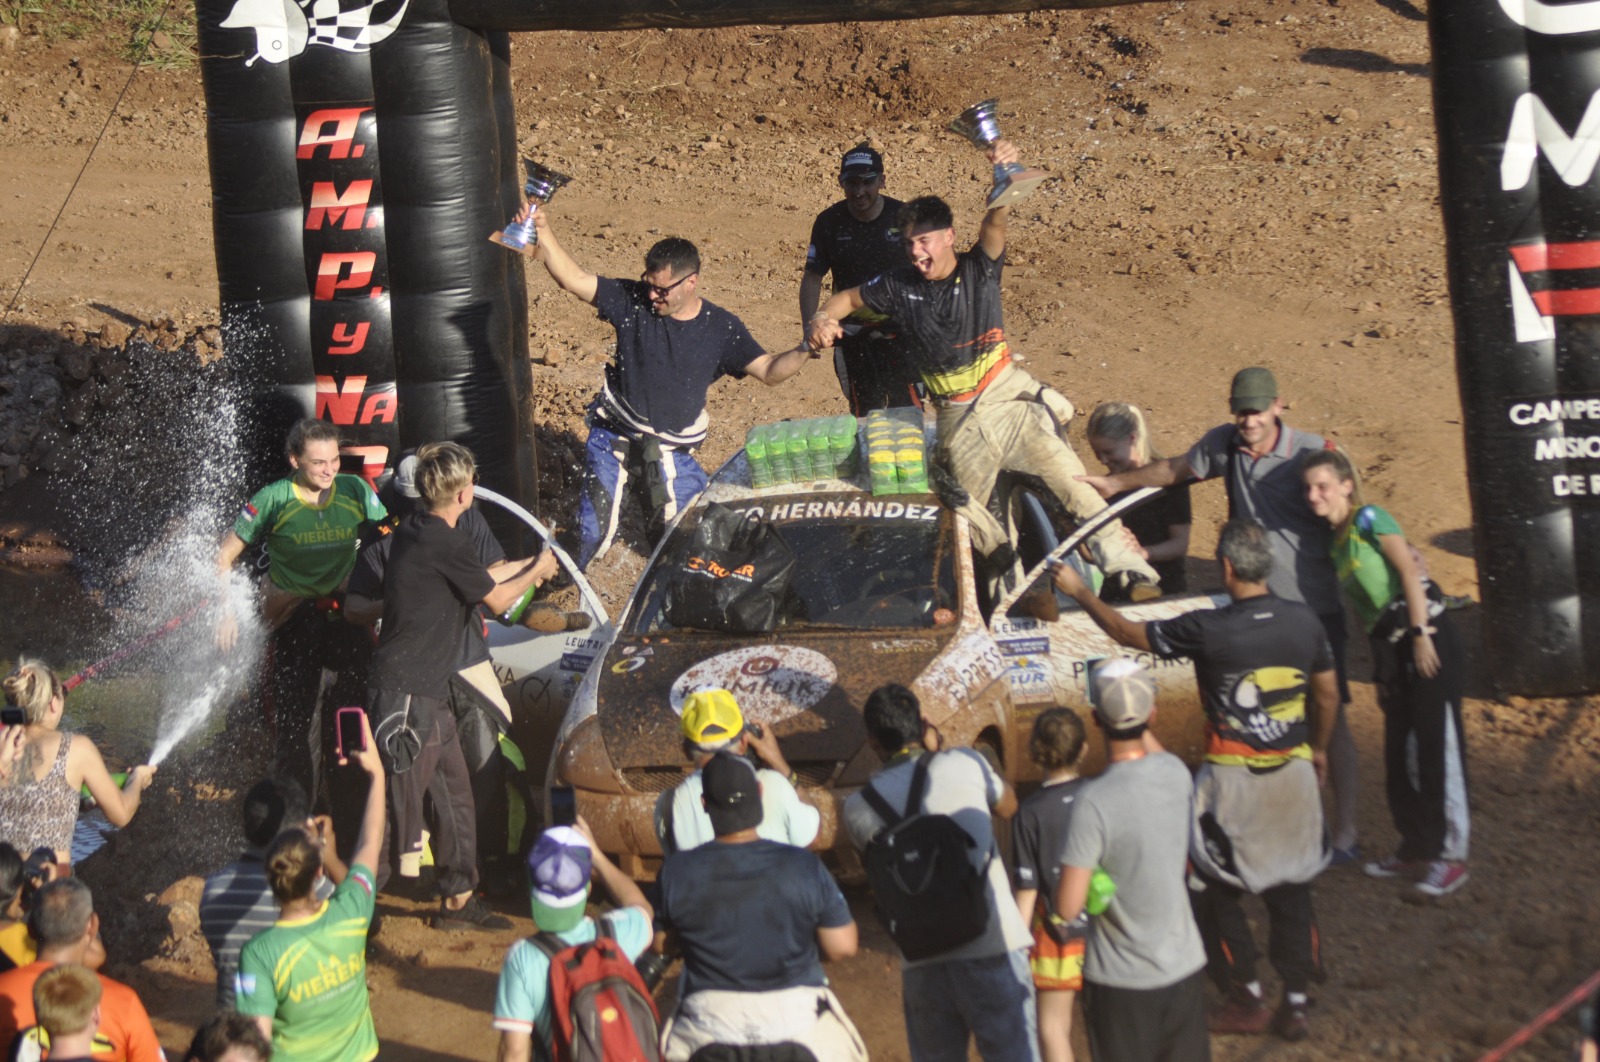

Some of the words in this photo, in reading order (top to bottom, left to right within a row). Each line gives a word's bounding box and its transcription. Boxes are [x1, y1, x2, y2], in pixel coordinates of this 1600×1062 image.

[1553, 475, 1586, 496] DE
[770, 497, 940, 521] HERNÁNDEZ
[292, 525, 353, 545] VIEREÑA
[315, 521, 330, 530] LA
[317, 954, 341, 973] LA
